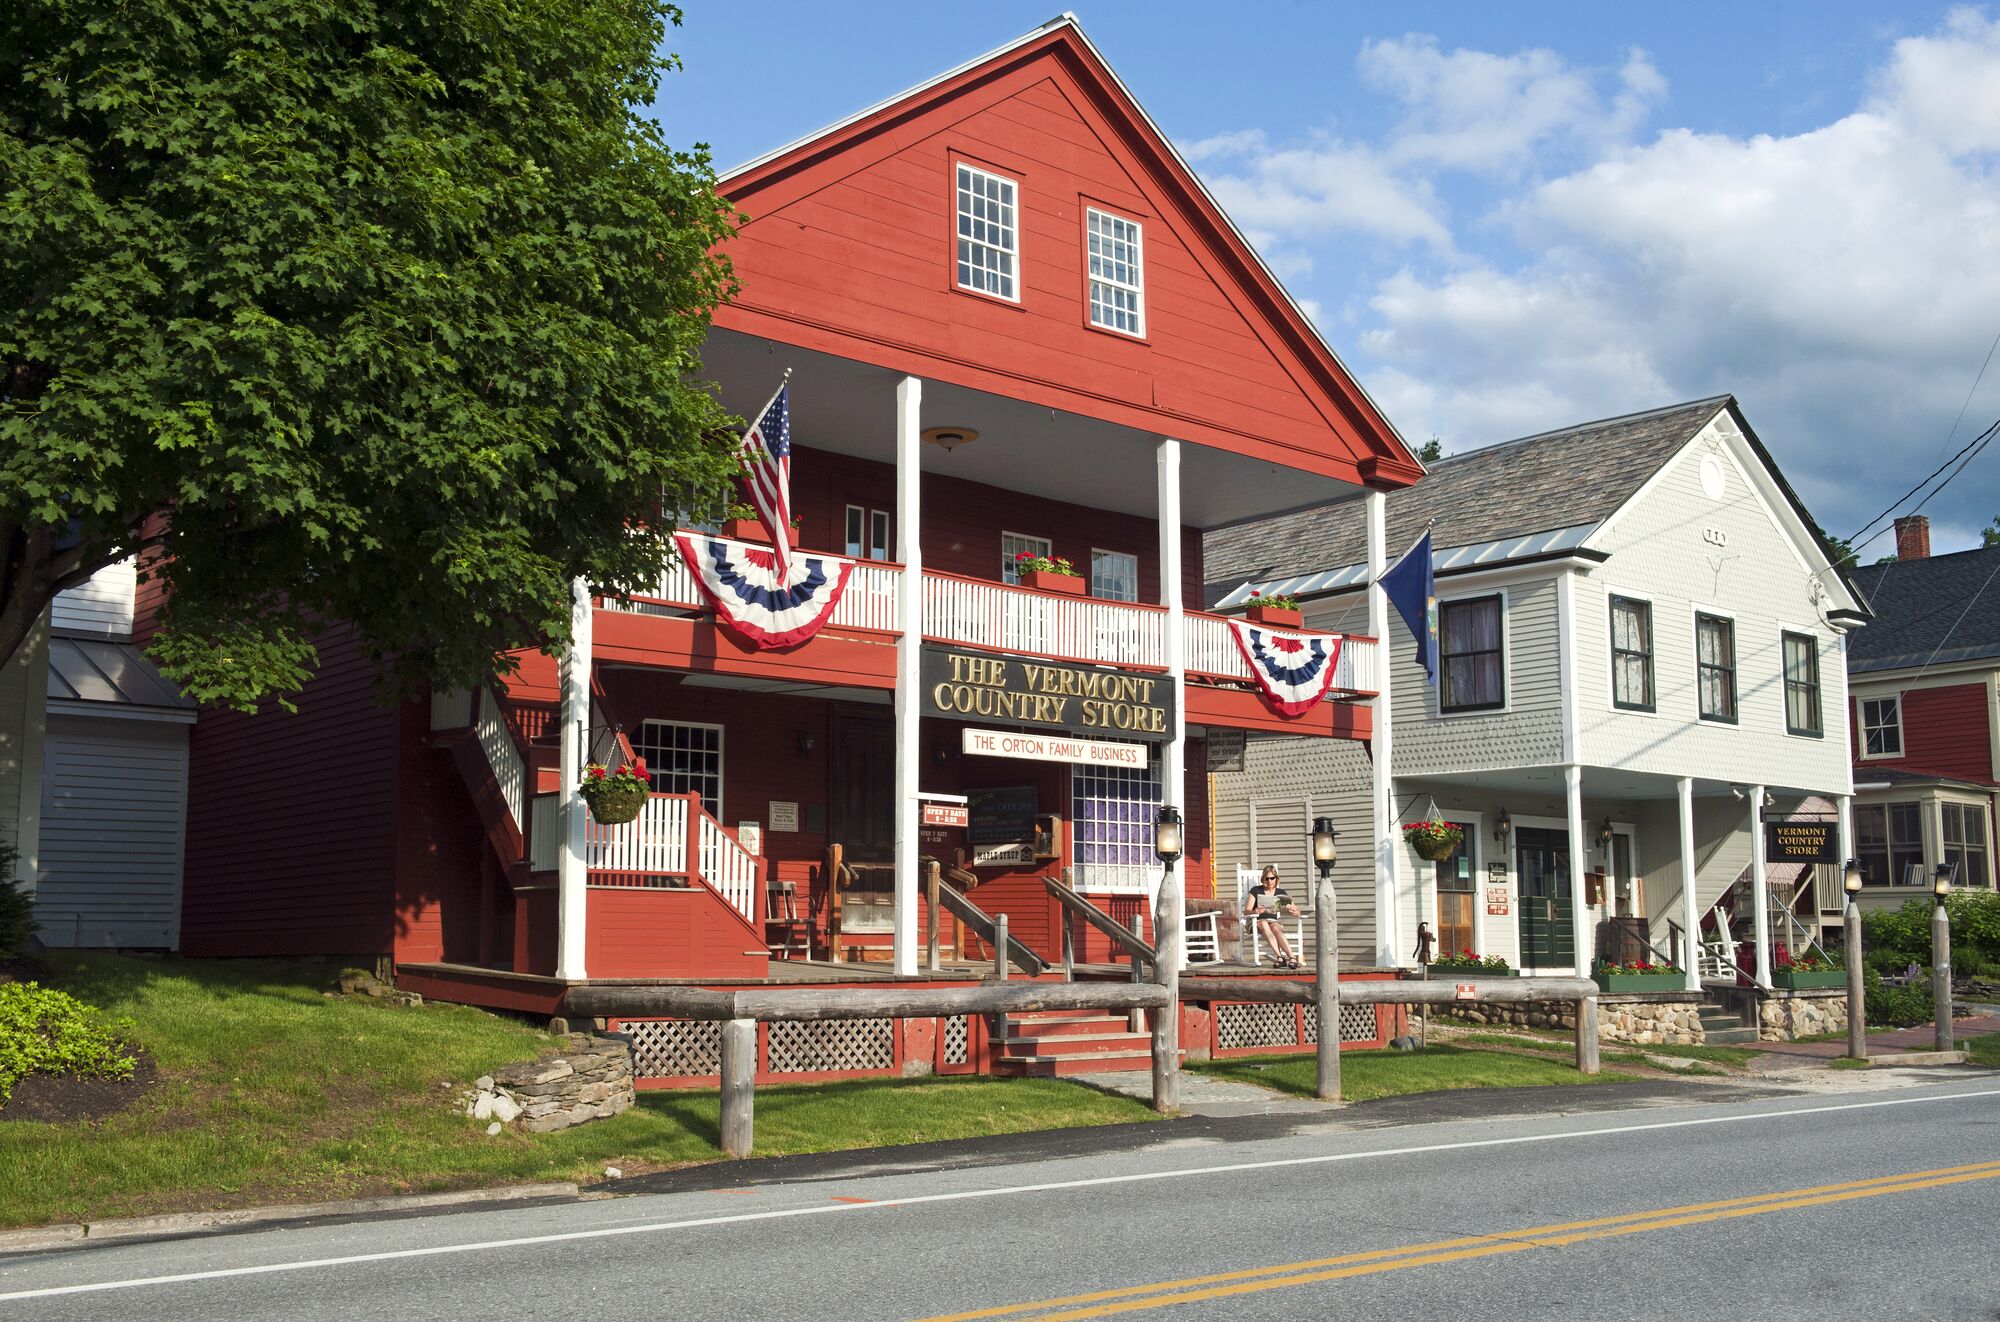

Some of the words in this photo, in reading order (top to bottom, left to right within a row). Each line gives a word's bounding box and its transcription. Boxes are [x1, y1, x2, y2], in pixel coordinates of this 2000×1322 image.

[948, 654, 1006, 687] THE
[1022, 663, 1154, 704] VERMONT
[933, 682, 1068, 724] COUNTRY
[1082, 700, 1167, 733] STORE
[974, 735, 996, 751] THE
[1002, 737, 1043, 755] ORTON
[1049, 741, 1084, 758] FAMILY
[1090, 747, 1137, 763] BUSINESS
[1777, 827, 1827, 836] VERMONT
[1778, 836, 1825, 845] COUNTRY
[976, 851, 998, 861] MAPLE
[999, 850, 1019, 860] SYRUP
[1785, 846, 1819, 855] STORE
